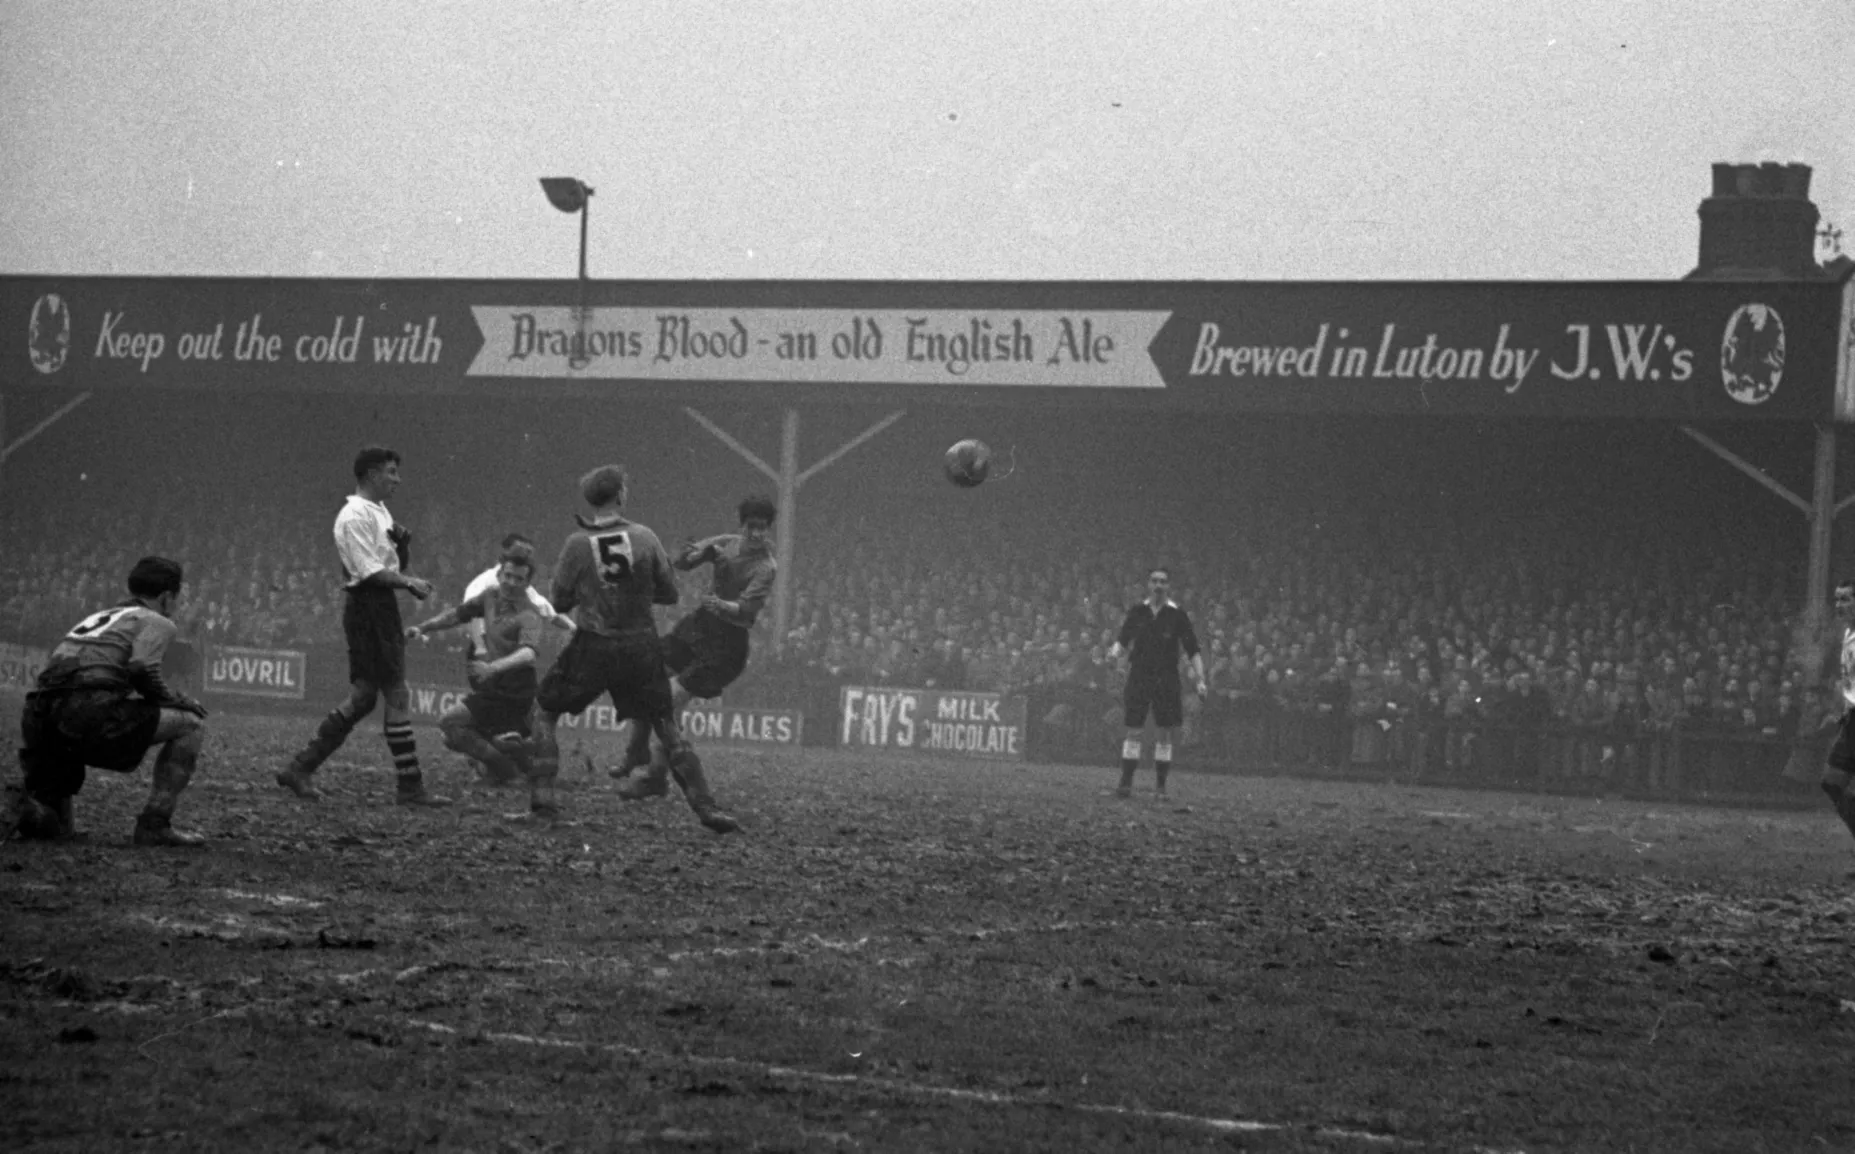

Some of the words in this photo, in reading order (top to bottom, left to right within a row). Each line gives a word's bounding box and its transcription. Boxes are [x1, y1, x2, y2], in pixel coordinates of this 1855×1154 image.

[95, 310, 164, 372] Keep
[177, 323, 224, 360] out
[234, 313, 281, 361] the
[295, 315, 365, 362] cold
[372, 315, 443, 363] with
[508, 311, 642, 370] Dragons
[653, 315, 748, 364] Blood
[775, 330, 817, 360] an
[831, 316, 882, 360] old
[905, 316, 1034, 375] English
[1046, 316, 1115, 366] Ale
[1188, 322, 1329, 379] Brewed
[1329, 328, 1368, 379] in
[1371, 323, 1483, 379] Luton
[1490, 323, 1539, 393] by
[598, 535, 631, 583] 5
[730, 713, 792, 743] ALES
[938, 697, 1001, 722] MILK
